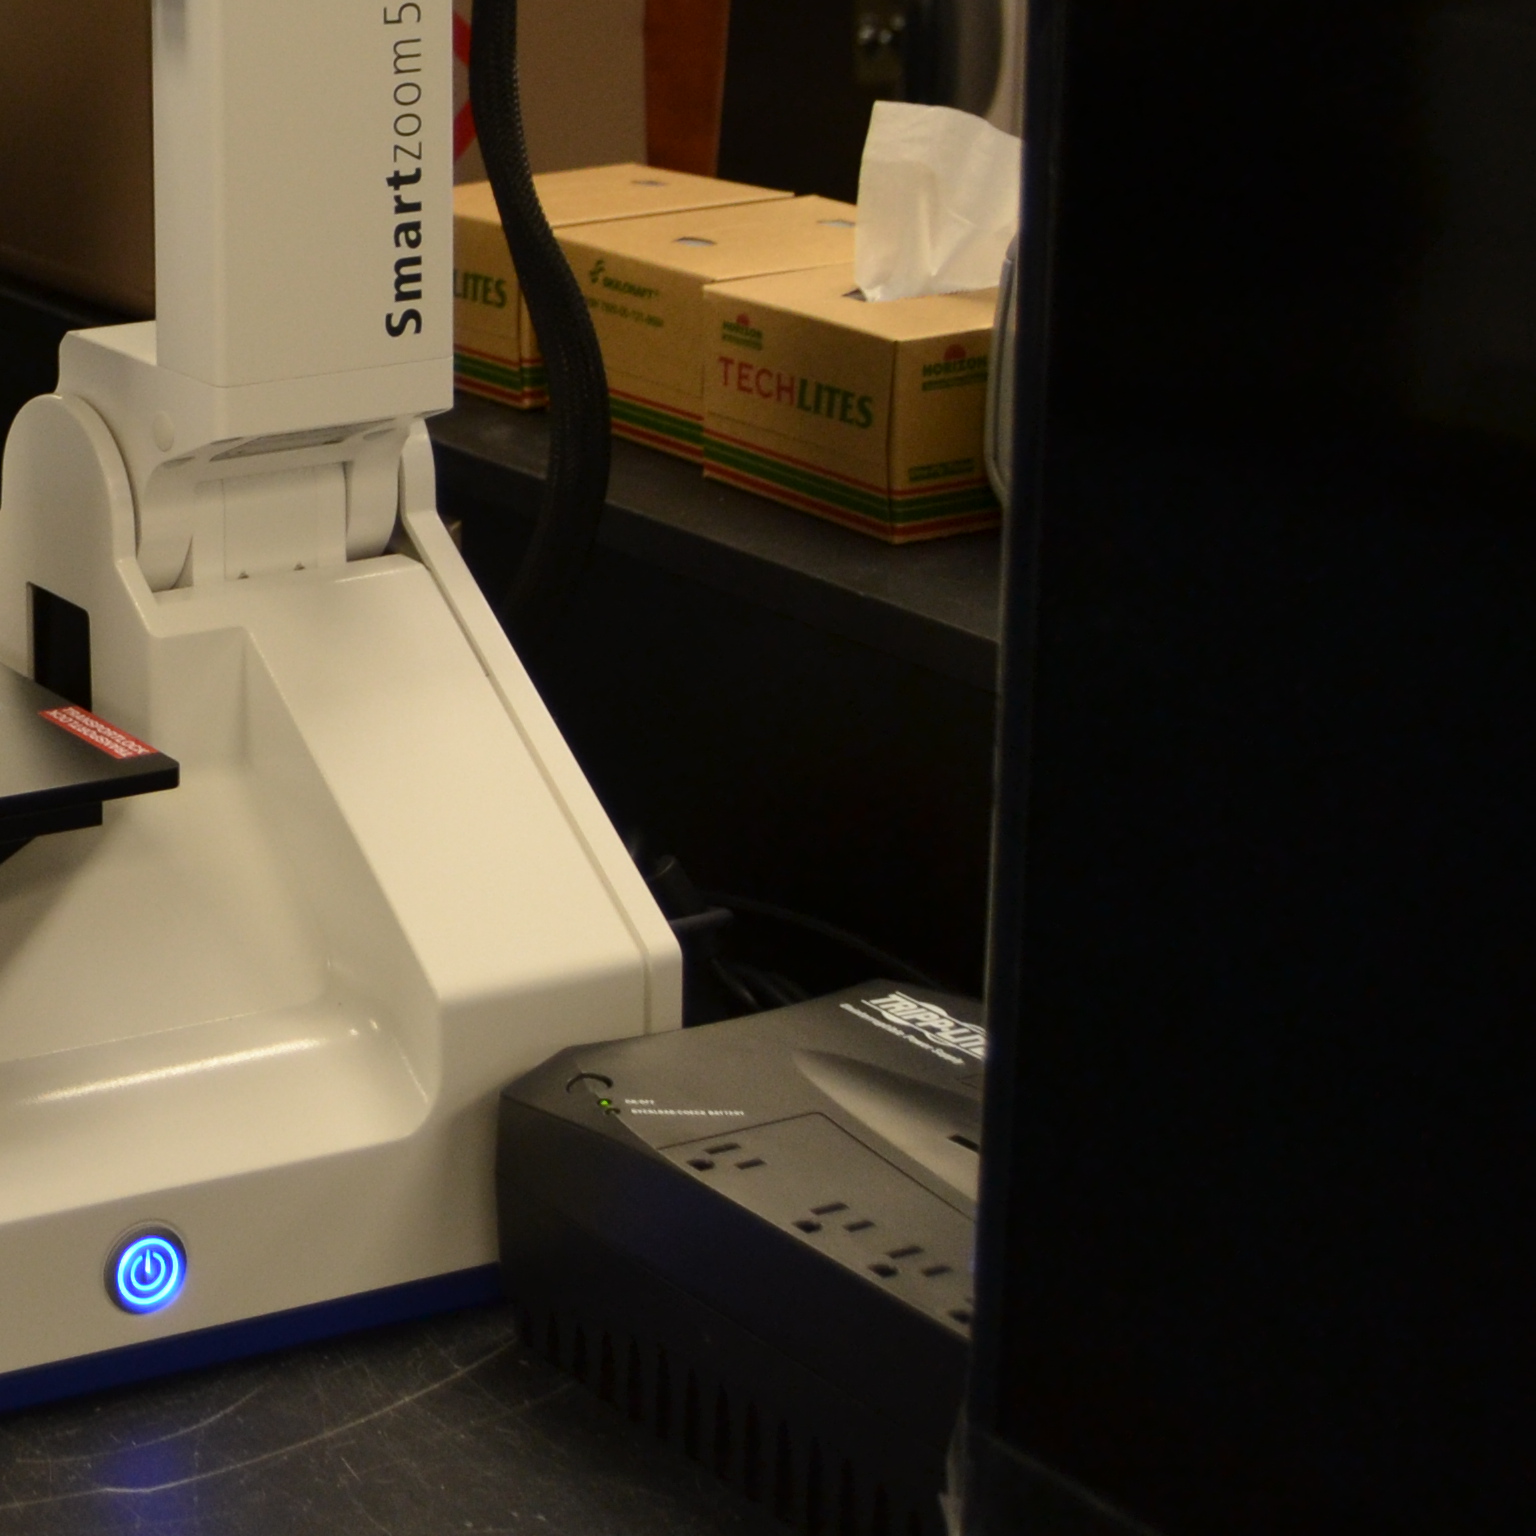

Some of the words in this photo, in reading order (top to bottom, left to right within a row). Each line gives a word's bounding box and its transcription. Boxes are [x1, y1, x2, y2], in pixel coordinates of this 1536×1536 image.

[383, 1, 422, 25] 5
[384, 37, 423, 338] Smartzoom
[718, 355, 874, 430] TECHLITES
